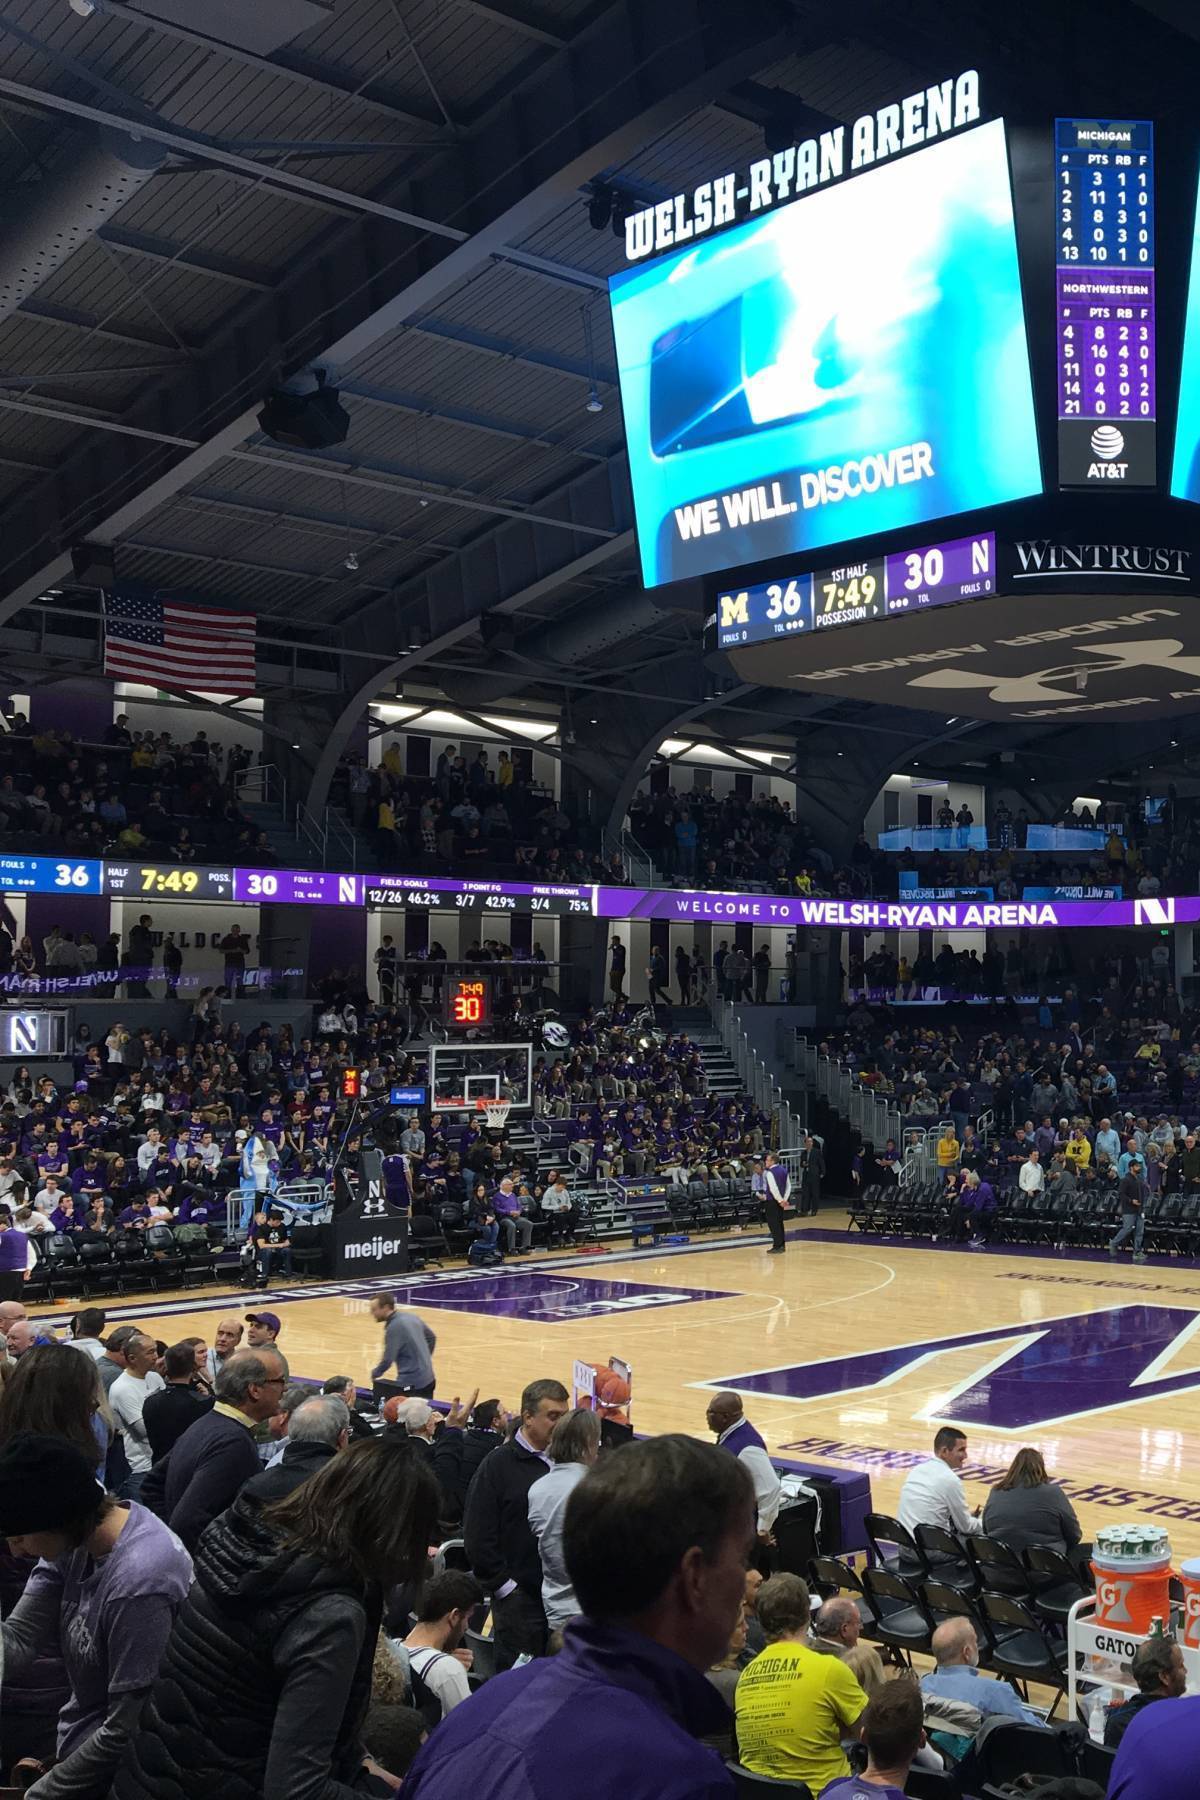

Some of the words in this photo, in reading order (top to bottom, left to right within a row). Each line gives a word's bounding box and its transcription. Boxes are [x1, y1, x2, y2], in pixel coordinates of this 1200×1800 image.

[1077, 130, 1131, 141] MICHIGAN
[624, 126, 845, 260] WELSH-RYAN
[851, 69, 980, 170] ARENA
[1088, 154, 1109, 165] PTS
[1116, 155, 1132, 165] RB
[1139, 156, 1147, 166] F
[1062, 171, 1070, 184] 1
[1093, 172, 1102, 185] 3
[1118, 173, 1126, 186] 1
[1138, 173, 1146, 186] 1
[1062, 190, 1072, 204] 2
[1090, 191, 1106, 204] 11
[1118, 192, 1126, 205] 1
[1138, 192, 1148, 206] 0
[1062, 208, 1072, 222] 3
[1094, 210, 1104, 223] 8
[1118, 210, 1127, 224] 3
[1138, 211, 1146, 224] 1
[1062, 228, 1073, 241] 4
[1094, 228, 1104, 242] 0
[1118, 229, 1127, 242] 3
[1139, 230, 1148, 243] 0
[1062, 246, 1078, 260] 13
[1090, 247, 1107, 260] 10
[1118, 248, 1126, 261] 1
[1139, 248, 1148, 262] 0
[1063, 284, 1148, 295] NORTHWESTERN
[1090, 308, 1110, 318] PTS
[1116, 308, 1132, 318] RB
[1140, 309, 1148, 319] F
[1064, 326, 1074, 338] 4
[1094, 326, 1104, 340] 8
[1120, 327, 1128, 340] 2
[1140, 328, 1148, 340] 3
[1064, 344, 1074, 358] 5
[1091, 345, 1108, 358] 16
[1118, 346, 1128, 358] 4
[1140, 346, 1148, 359] 0
[1064, 363, 1080, 376] 11
[1095, 364, 1105, 377] 0
[1119, 364, 1128, 377] 3
[1140, 364, 1148, 378] 1
[1064, 382, 1080, 394] 14
[1095, 382, 1105, 395] 4
[1120, 382, 1129, 396] 0
[1140, 383, 1148, 396] 2
[1065, 400, 1080, 414] 21
[1096, 400, 1106, 414] 0
[1120, 402, 1129, 414] 2
[1140, 401, 1149, 415] 0
[1087, 463, 1128, 478] AT&T
[675, 500, 721, 540] WE
[722, 481, 798, 528] WILL.
[800, 440, 935, 509] DISCOVER
[971, 539, 990, 574] N
[1013, 538, 1191, 574] WINTRUST
[831, 568, 845, 582] 1ST
[847, 563, 868, 578] HALF
[904, 547, 944, 590] 30
[822, 575, 876, 612] 7:49
[960, 582, 981, 595] FOULS
[985, 580, 991, 591] 0
[766, 580, 801, 620] 36
[918, 593, 930, 603] TOL
[720, 592, 749, 627] M
[816, 608, 867, 626] POSSESSION
[774, 623, 785, 632] TOL
[722, 631, 740, 644] FOULS
[742, 630, 748, 641] 0
[1, 860, 25, 869] FOULS
[31, 861, 37, 870] 0
[108, 867, 129, 877] HALF
[1, 877, 14, 886] TOL
[55, 864, 89, 887] 36
[140, 869, 199, 892] 7:49
[208, 872, 231, 883] POSS.
[293, 876, 314, 884] FOULS
[380, 878, 402, 888] FIELD
[403, 880, 428, 888] GOALS
[110, 880, 124, 889] 1ST
[247, 875, 278, 895] 30
[339, 877, 356, 903] N
[462, 882, 468, 890] 3
[468, 882, 490, 891] POINT
[490, 883, 502, 892] FG
[533, 886, 550, 895] FREE
[551, 887, 579, 896] THROWS
[294, 891, 305, 899] TOL
[368, 889, 402, 905] 12/26
[407, 891, 440, 906] 46.2%
[455, 894, 475, 907] 3/7
[485, 894, 516, 909] 42.9%
[530, 897, 550, 911] 3/4
[568, 899, 589, 912] 75%
[1134, 897, 1175, 925] N
[676, 900, 761, 915] WELCOME
[770, 905, 790, 916] TO
[800, 901, 957, 926] WELSH-RYAN
[962, 904, 1058, 925] ARENA
[459, 983, 484, 995] 7:49
[455, 998, 480, 1021] 30
[344, 1236, 401, 1260] meijer
[1101, 1583, 1115, 1606] G
[1187, 1593, 1200, 1616] G
[742, 1658, 801, 1677] MICHIGAN
